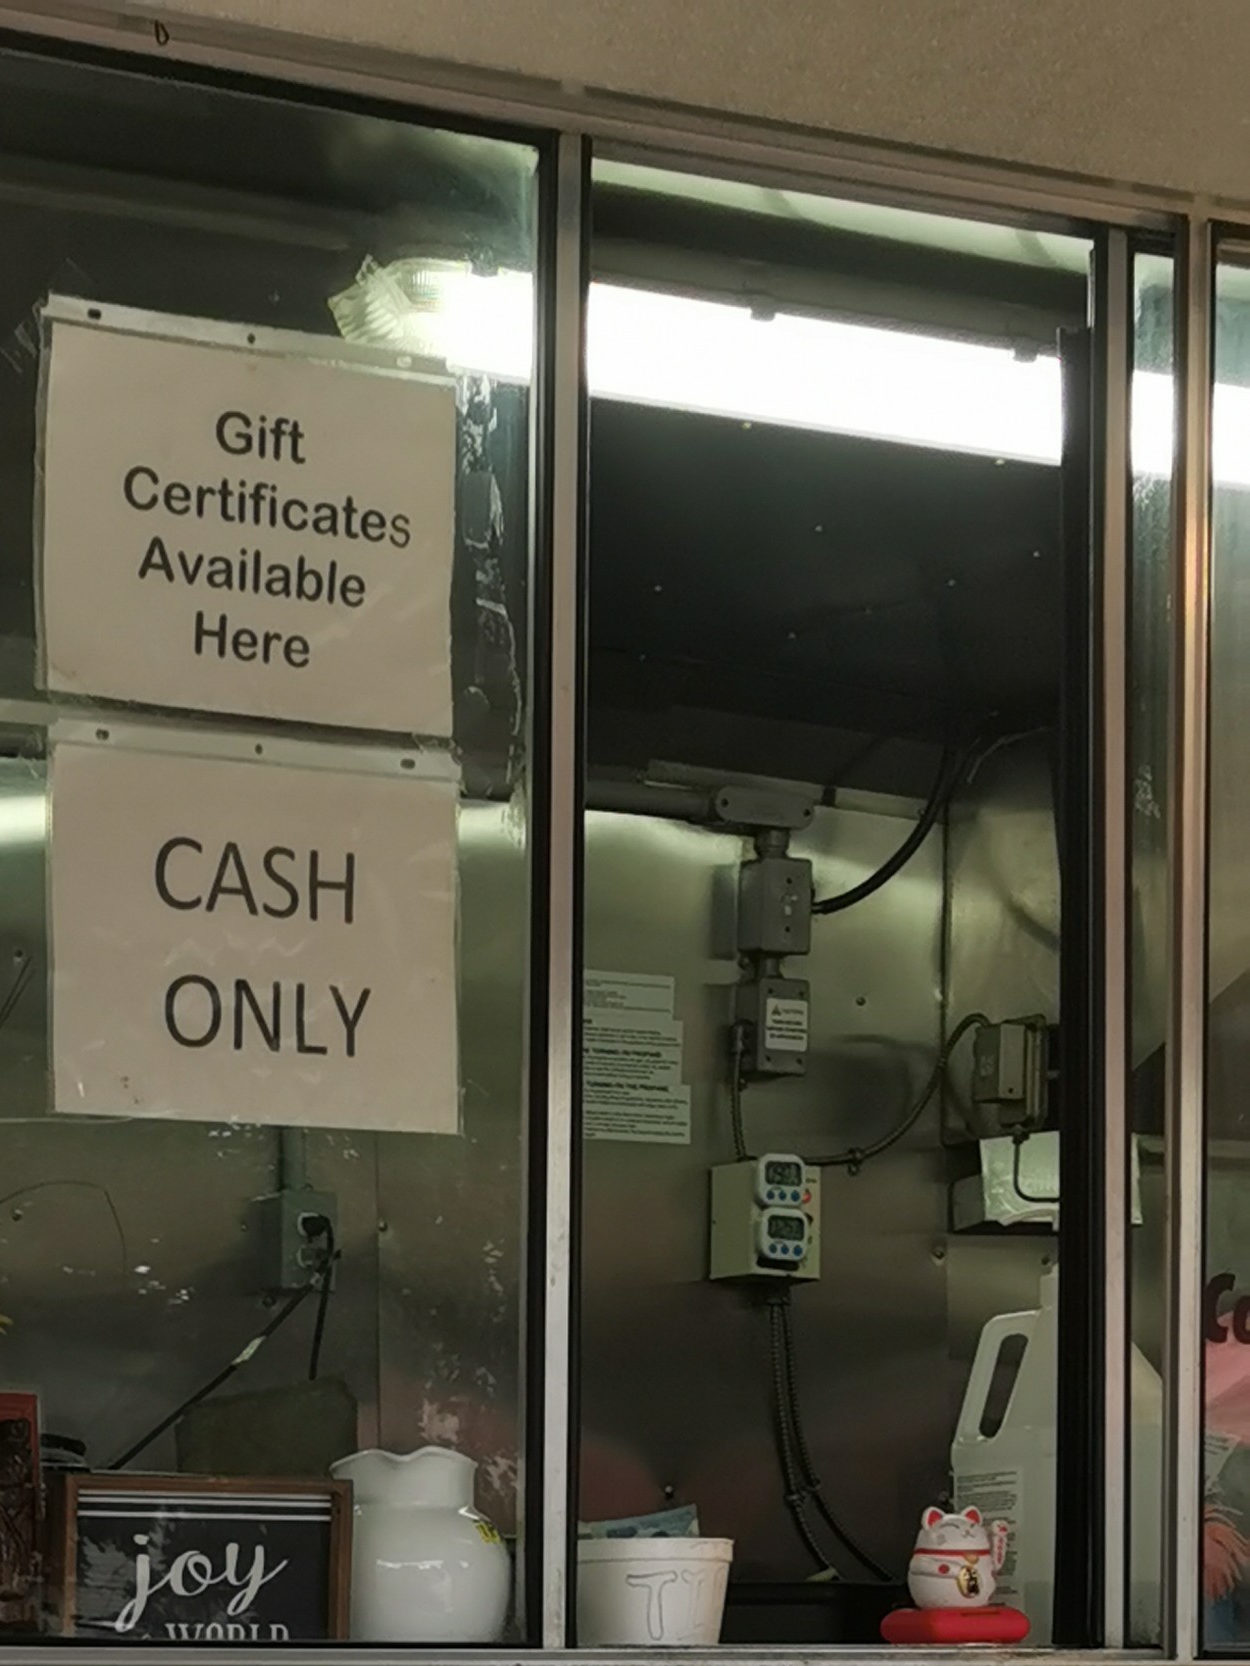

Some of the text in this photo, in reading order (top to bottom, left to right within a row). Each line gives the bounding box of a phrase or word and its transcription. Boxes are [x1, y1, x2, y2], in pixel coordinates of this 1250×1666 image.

[214, 410, 306, 465] Gift
[123, 465, 412, 549] Certificates
[137, 536, 366, 608] Available
[194, 610, 311, 669] Here
[154, 836, 355, 925] CASH
[164, 974, 371, 1058] ONLY
[115, 1534, 289, 1633] joy
